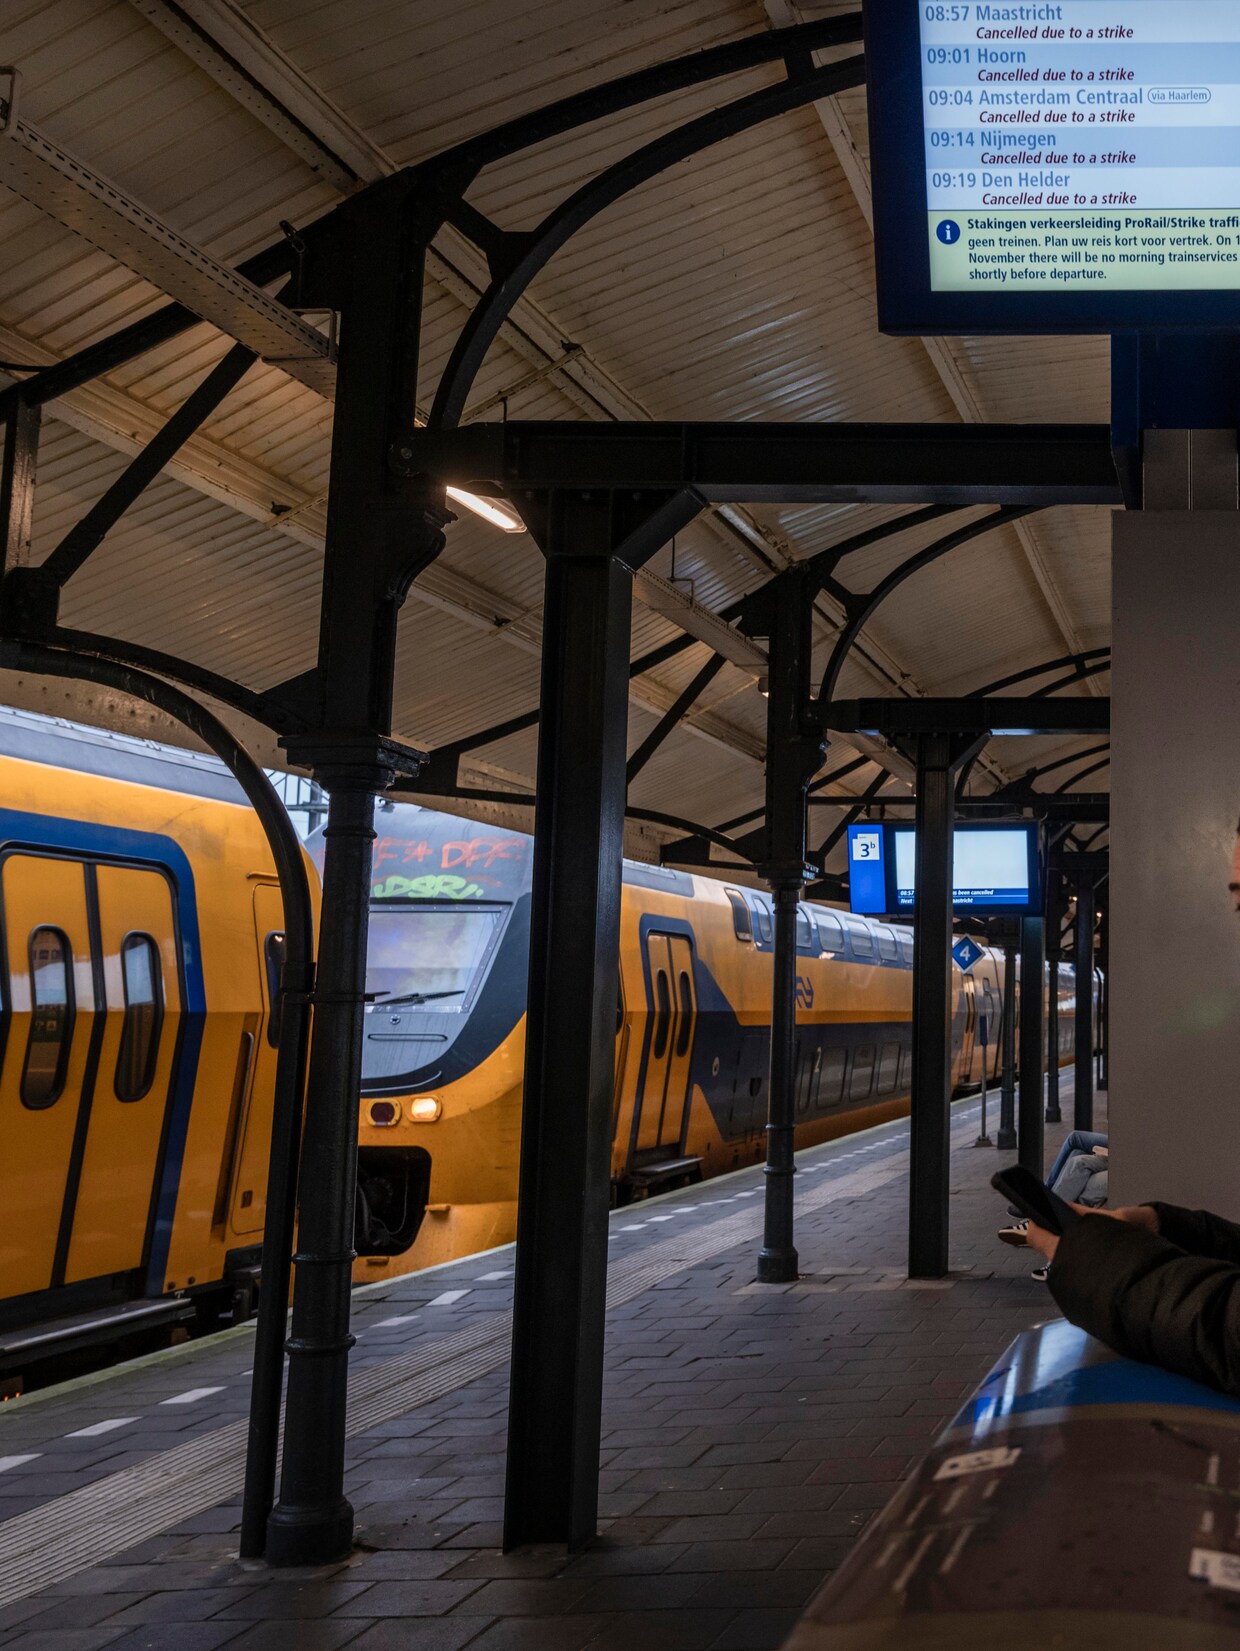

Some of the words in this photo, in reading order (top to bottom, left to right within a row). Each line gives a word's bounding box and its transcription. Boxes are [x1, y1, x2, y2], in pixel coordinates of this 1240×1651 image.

[926, 6, 969, 21] 08:57
[976, 4, 1062, 20] Maastricht
[977, 26, 1038, 39] Cancelled
[1042, 26, 1064, 38] due
[1070, 27, 1082, 38] to
[1086, 29, 1093, 38] a
[1098, 25, 1133, 38] strike
[927, 48, 969, 63] 09:01
[978, 48, 1025, 63] Hoorn
[978, 69, 1039, 81] Cancelled
[1043, 68, 1066, 81] due
[1071, 70, 1083, 80] to
[1087, 72, 1094, 80] a
[1099, 68, 1134, 80] strike
[929, 90, 973, 105] 09:04
[979, 88, 1070, 105] Amsterdam
[1077, 88, 1142, 104] Centraal
[1151, 90, 1165, 101] via
[1169, 90, 1207, 101] Haarlem
[980, 110, 1040, 123] Cancelled
[1044, 110, 1067, 122] due
[1072, 112, 1084, 122] to
[1088, 113, 1095, 122] a
[1100, 109, 1135, 122] strike
[931, 132, 974, 147] 09:14
[981, 130, 1056, 149] Nijmegen
[981, 151, 1041, 164] Cancelled
[1045, 151, 1068, 163] due
[1073, 153, 1085, 163] to
[1089, 155, 1096, 163] a
[1101, 151, 1136, 163] strike
[933, 173, 976, 188] 09:19
[982, 173, 1012, 187] Den
[1019, 171, 1070, 187] Helder
[983, 192, 1043, 204] Cancelled
[1047, 192, 1069, 204] due
[1074, 194, 1086, 204] to
[1090, 195, 1097, 204] a
[1102, 192, 1136, 204] strike
[968, 218, 1026, 232] Stakingen
[1030, 217, 1121, 231] verkeersleiding
[1125, 217, 1205, 228] ProRail/Strike
[968, 239, 995, 249] geen
[999, 236, 1040, 247] treinen.
[1045, 236, 1068, 246] Plan
[1072, 238, 1088, 246] uw
[1092, 235, 1111, 246] reis
[1115, 235, 1137, 246] kort
[1141, 238, 1166, 246] voor
[1170, 235, 1212, 245] vertrek.
[1216, 235, 1231, 245] On
[969, 252, 1025, 263] November
[1029, 252, 1057, 263] there
[1061, 252, 1080, 262] will
[1085, 252, 1098, 262] be
[1102, 254, 1115, 262] no
[1119, 251, 1164, 265] morning
[1168, 251, 1237, 262] trainservices
[970, 268, 1007, 281] shortly
[1011, 268, 1046, 279] before
[1050, 268, 1106, 281] departure.
[959, 945, 970, 961] 4
